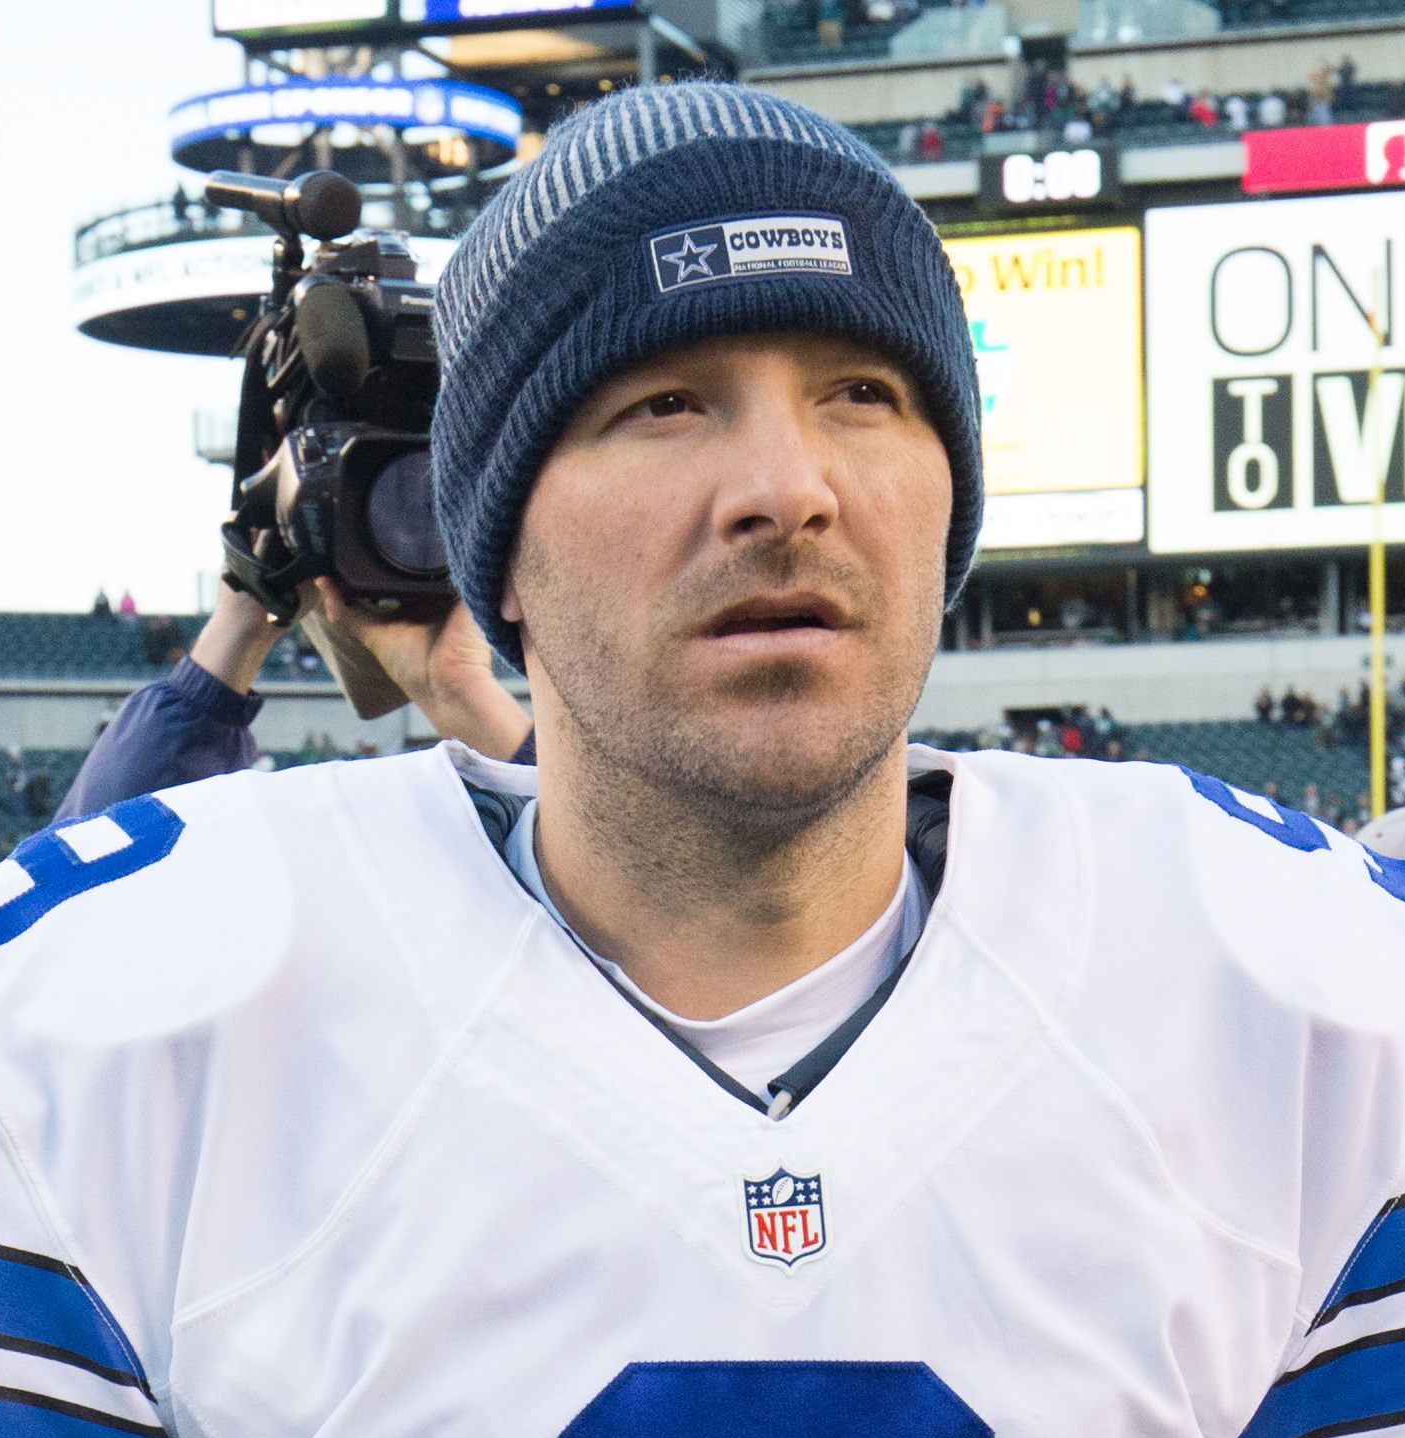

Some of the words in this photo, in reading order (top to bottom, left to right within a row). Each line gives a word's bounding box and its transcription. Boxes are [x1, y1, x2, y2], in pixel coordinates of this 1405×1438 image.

[729, 228, 844, 251] COWBOYS
[735, 261, 775, 271] NATIONAL
[778, 259, 818, 267] FOOTBALL
[991, 248, 1104, 292] Win!
[1209, 238, 1394, 356] ON
[1226, 378, 1280, 509] TO
[754, 1209, 820, 1254] NFL
